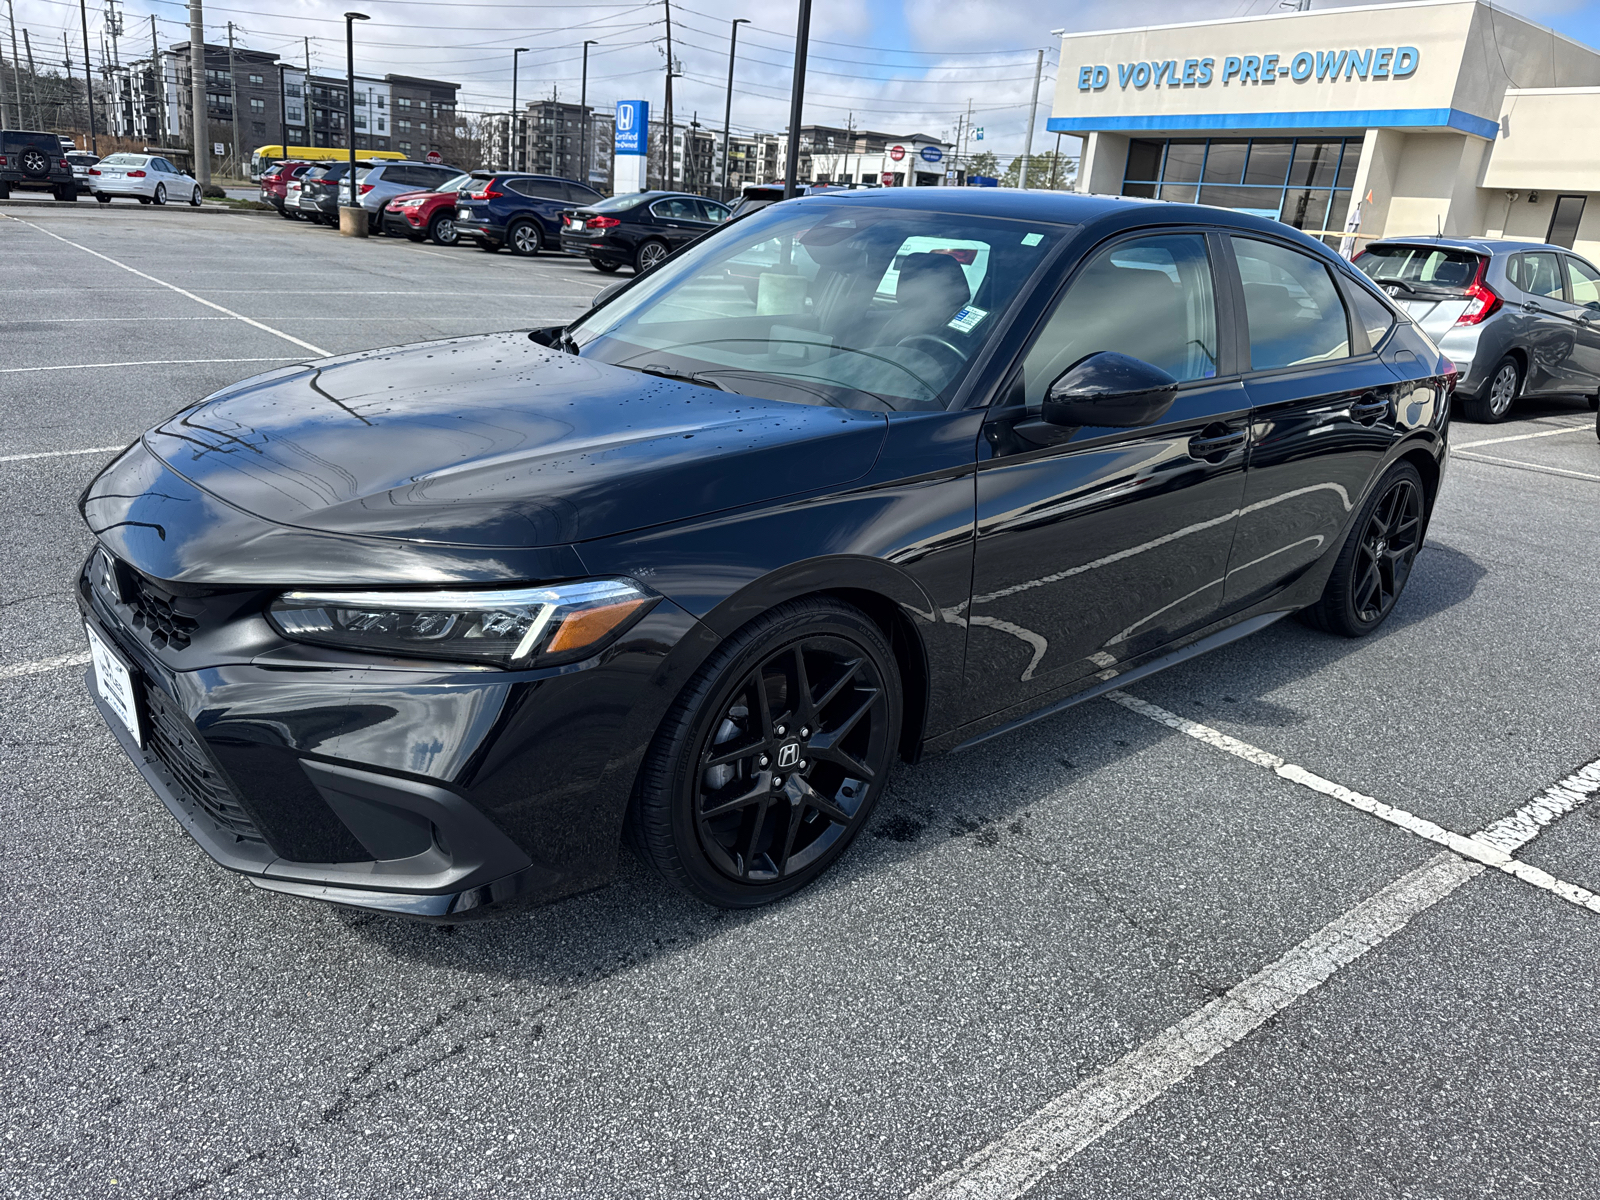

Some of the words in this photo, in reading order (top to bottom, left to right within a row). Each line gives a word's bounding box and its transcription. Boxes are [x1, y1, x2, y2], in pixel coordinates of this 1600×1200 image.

[1078, 66, 1109, 91] ED
[1118, 58, 1215, 89] VOYLES
[1221, 46, 1420, 83] PRE-OWNED
[858, 625, 889, 659] ULTRAMAX
[677, 727, 698, 782] SUMMIT
